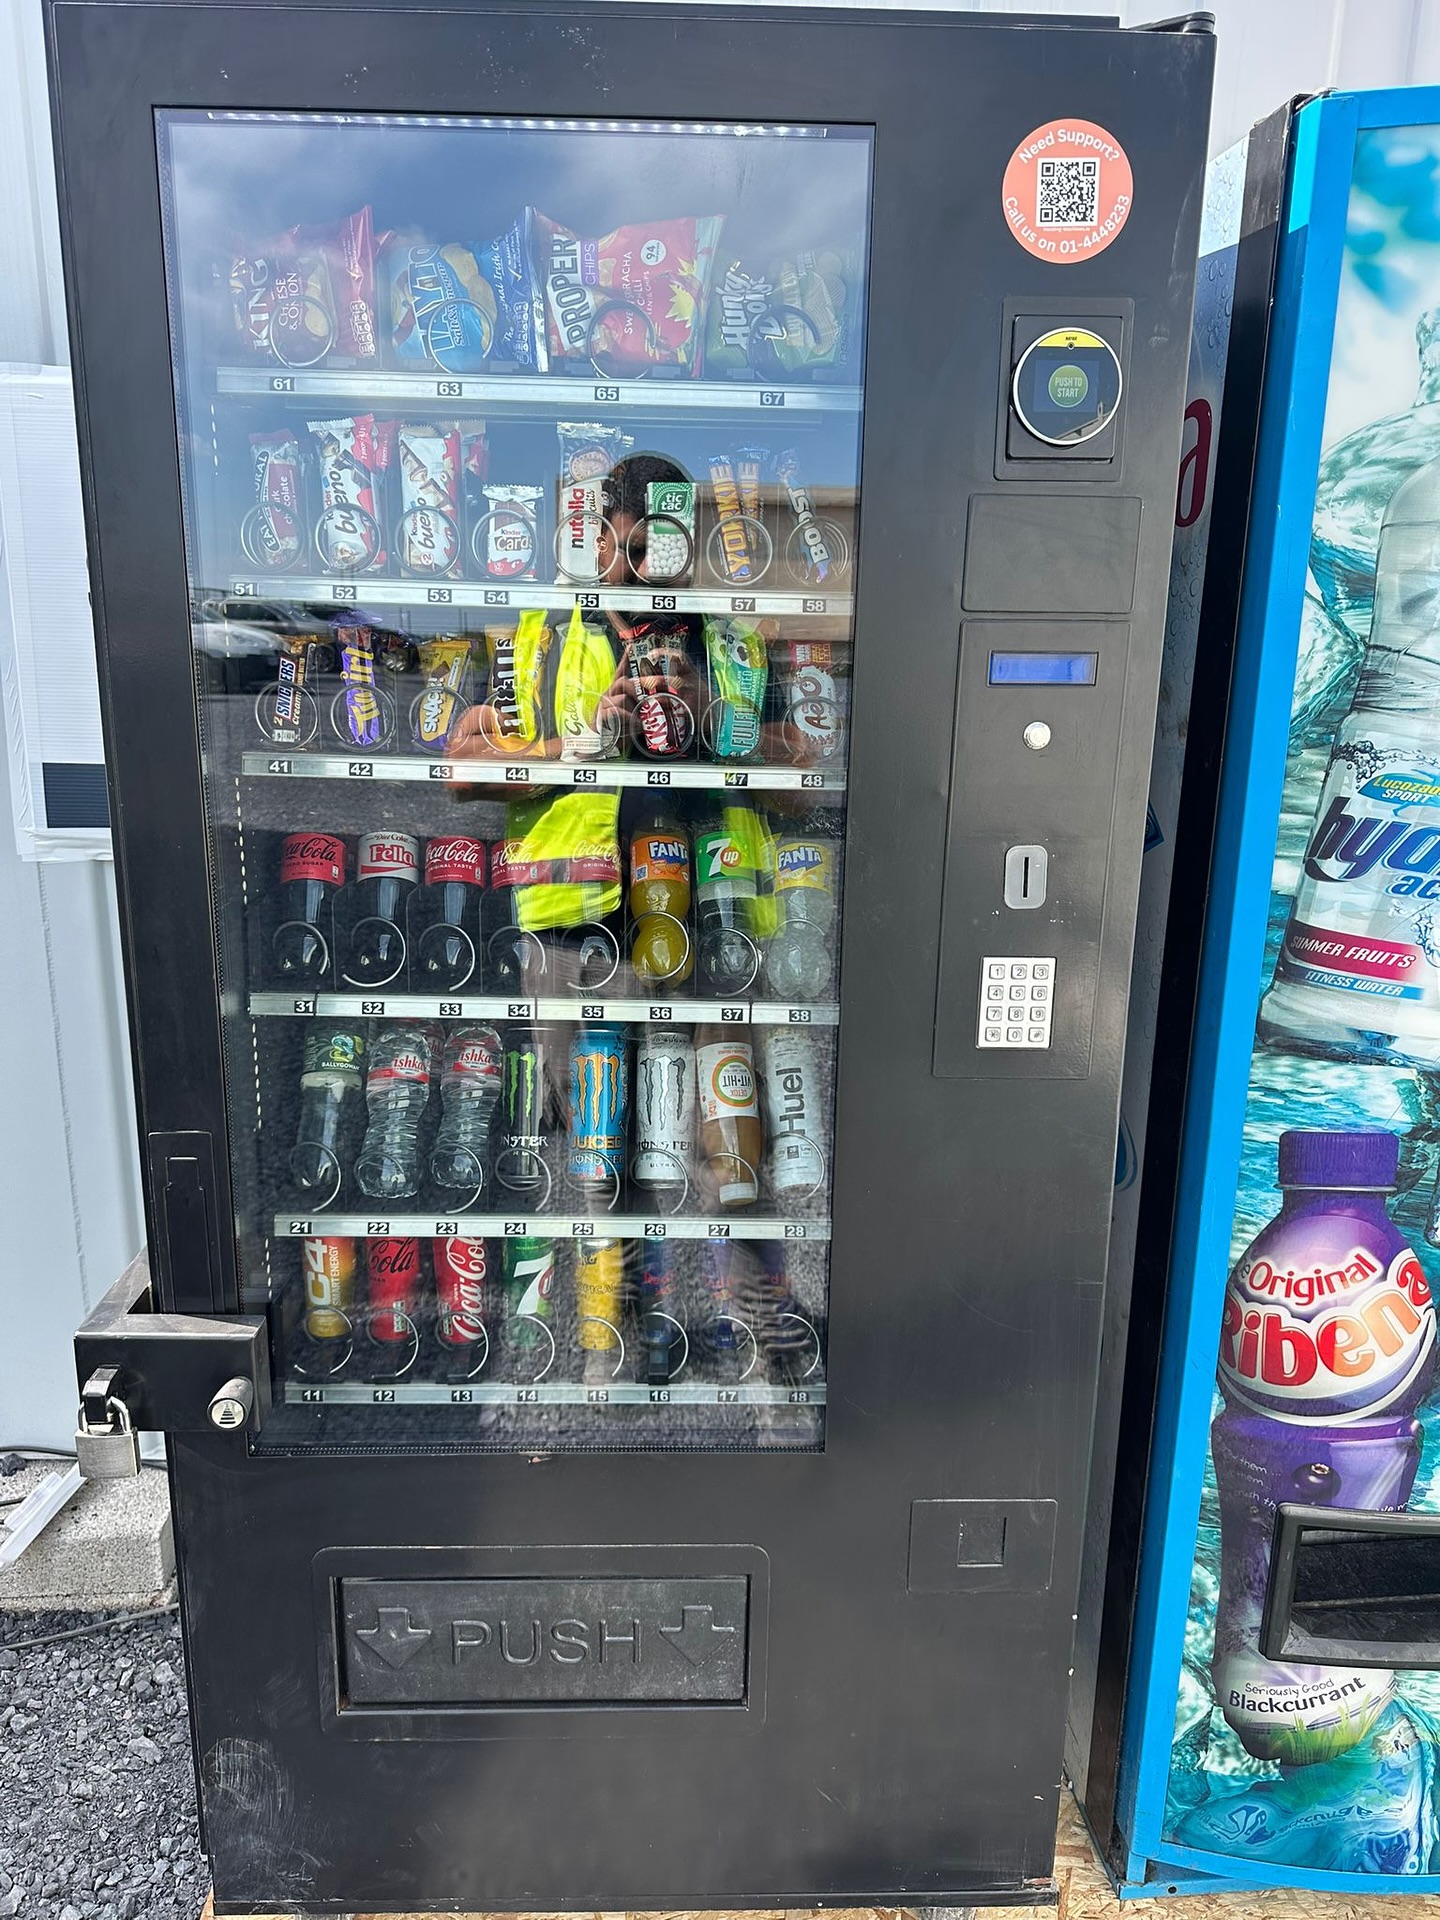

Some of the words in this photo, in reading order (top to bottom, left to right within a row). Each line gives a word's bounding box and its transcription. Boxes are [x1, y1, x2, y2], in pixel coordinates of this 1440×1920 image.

[1018, 131, 1055, 164] Need
[1057, 128, 1120, 162] Support?
[1005, 196, 1024, 228] Call
[1020, 226, 1037, 243] us
[1038, 238, 1056, 252] on
[1059, 194, 1130, 254] 01-4448233
[645, 244, 656, 261] 94
[584, 242, 597, 285] CHIPS
[549, 235, 593, 344] PROPER
[248, 257, 270, 350] KING
[276, 278, 289, 327] CHESE
[407, 243, 454, 359] TAYTO
[716, 258, 752, 350] Hunky
[273, 378, 292, 390] 61
[1055, 376, 1073, 387] PUSH
[1073, 376, 1082, 387] TO
[438, 383, 459, 395] 63
[596, 388, 617, 400] 65
[1057, 388, 1079, 398] START
[762, 393, 783, 405] 67
[280, 475, 293, 525] chcolate
[665, 493, 682, 503] tic
[585, 488, 599, 526] bicuits
[660, 501, 682, 511] tac
[567, 488, 585, 550] nutella
[787, 486, 830, 563] BOOST
[234, 584, 254, 596] 51
[335, 587, 355, 599] 52
[429, 589, 450, 602] 53
[486, 591, 507, 603] 54
[577, 594, 597, 607] 55
[654, 596, 674, 609] 56
[734, 599, 753, 611] 57
[805, 600, 824, 612] 58
[276, 659, 295, 717] SNICERS
[292, 690, 302, 726] cream
[800, 674, 832, 730] Aeo
[269, 761, 289, 773] 41
[351, 764, 371, 776] 42
[430, 766, 451, 778] 43
[507, 768, 527, 780] 44
[575, 770, 595, 782] 45
[649, 772, 669, 784] 46
[728, 774, 747, 785] 47
[803, 775, 822, 787] 48
[1381, 788, 1432, 804] SPORT
[370, 844, 416, 866] Fella
[706, 837, 732, 878] 7
[778, 846, 822, 867] FANTA
[1289, 934, 1346, 957] SUMMER
[1348, 946, 1416, 970] FRUITS
[1304, 970, 1353, 987] FITNESS
[1353, 980, 1405, 997] WATER
[295, 1001, 313, 1013] 31
[364, 1002, 383, 1014] 32
[441, 1004, 461, 1015] 33
[509, 1005, 529, 1017] 34
[583, 1006, 602, 1018] 35
[651, 1008, 670, 1019] 36
[723, 1009, 742, 1020] 37
[790, 1011, 809, 1022] 38
[393, 1055, 424, 1069] ishka
[460, 1049, 491, 1063] ishka
[775, 1067, 806, 1136] Huel
[571, 1136, 622, 1149] JUICED
[291, 1222, 310, 1233] 21
[369, 1223, 388, 1234] 22
[438, 1223, 456, 1234] 23
[506, 1223, 525, 1234] 24
[574, 1224, 592, 1235] 25
[646, 1225, 664, 1235] 26
[710, 1226, 728, 1236] 27
[786, 1227, 805, 1237] 28
[305, 1239, 331, 1306] C4
[1248, 1252, 1378, 1306] Original
[1221, 1256, 1433, 1387] Ribena
[303, 1390, 321, 1401] 11
[375, 1391, 393, 1401] 12
[453, 1391, 471, 1401] 13
[519, 1391, 537, 1401] 14
[589, 1391, 607, 1401] 15
[652, 1391, 669, 1401] 16
[720, 1391, 736, 1401] 17
[791, 1392, 807, 1402] 18
[451, 1618, 642, 1666] PUSH
[1244, 1682, 1300, 1698] Seriously
[1301, 1677, 1335, 1694] Good
[1229, 1676, 1367, 1714] Blackcurrant
